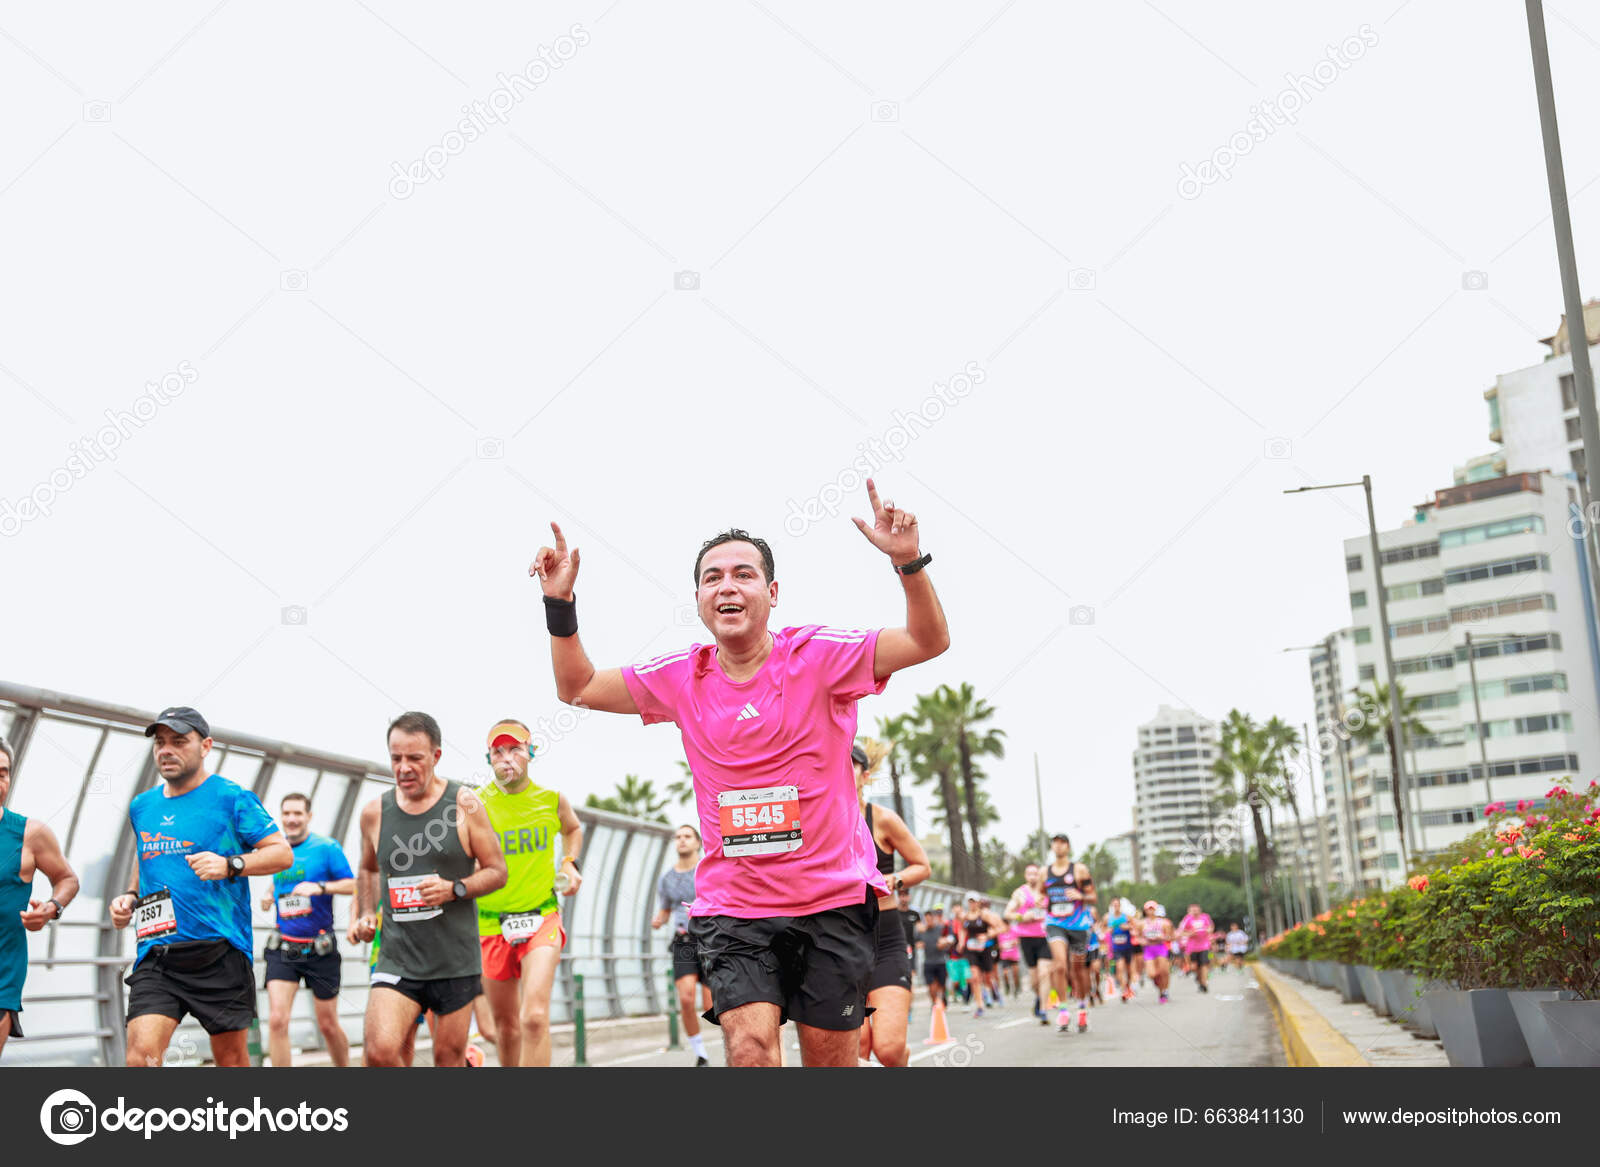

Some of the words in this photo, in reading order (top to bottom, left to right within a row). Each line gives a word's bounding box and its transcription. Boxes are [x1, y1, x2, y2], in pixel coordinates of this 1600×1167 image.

[731, 804, 786, 828] 5545
[496, 826, 547, 856] ERU
[752, 834, 767, 842] 21K
[142, 840, 182, 852] FARTLEK
[141, 904, 162, 922] 2587
[507, 919, 534, 930] 1267
